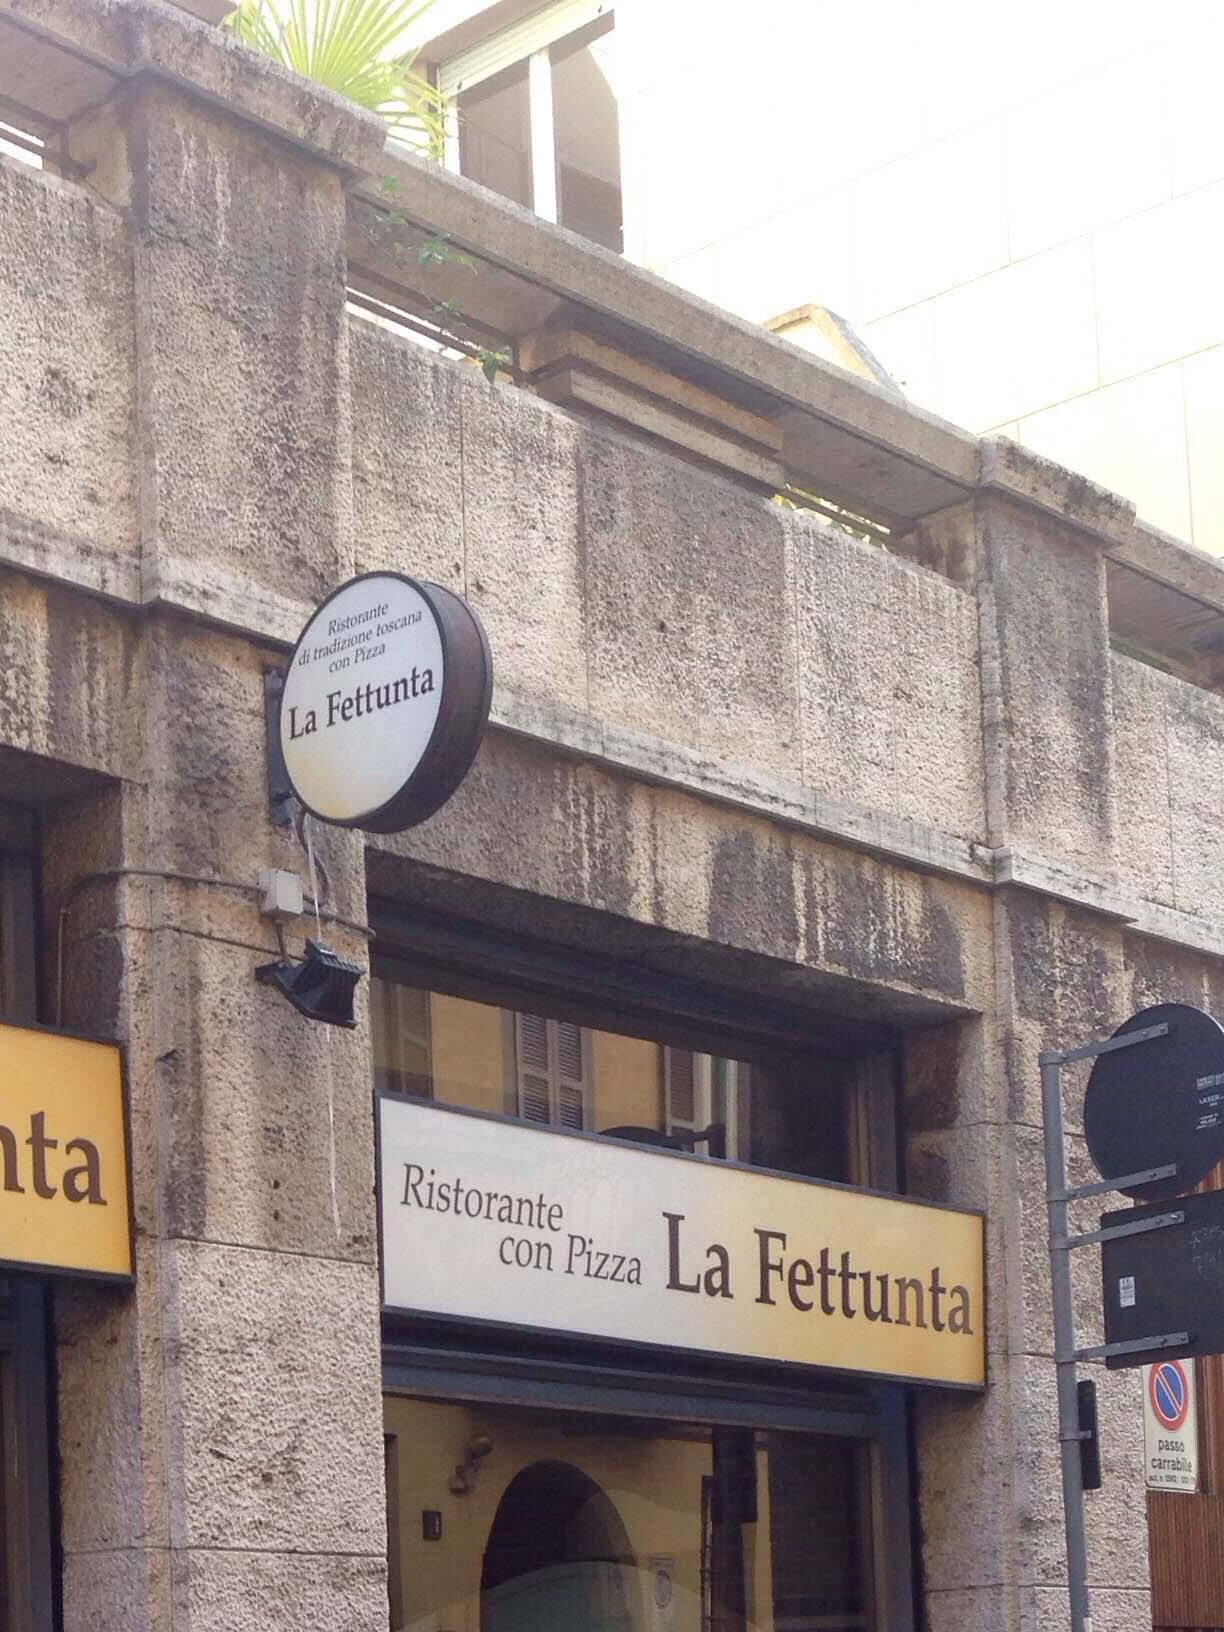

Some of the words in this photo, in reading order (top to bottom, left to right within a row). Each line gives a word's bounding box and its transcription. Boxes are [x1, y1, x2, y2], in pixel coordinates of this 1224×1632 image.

[298, 650, 310, 667] di
[313, 628, 373, 661] tradizione
[376, 610, 423, 637] toscana
[327, 602, 389, 637] Ristorante
[329, 656, 350, 673] con
[354, 642, 386, 664] Pizza
[288, 705, 318, 740] La
[326, 665, 435, 728] Fettunta
[400, 1164, 564, 1232] Ristorante
[498, 1233, 554, 1272] con
[565, 1234, 643, 1286] Pizza
[662, 1211, 734, 1299] La
[753, 1227, 974, 1336] Fettunta
[1151, 1456, 1192, 1473] carrabile
[1158, 1439, 1185, 1453] passo
